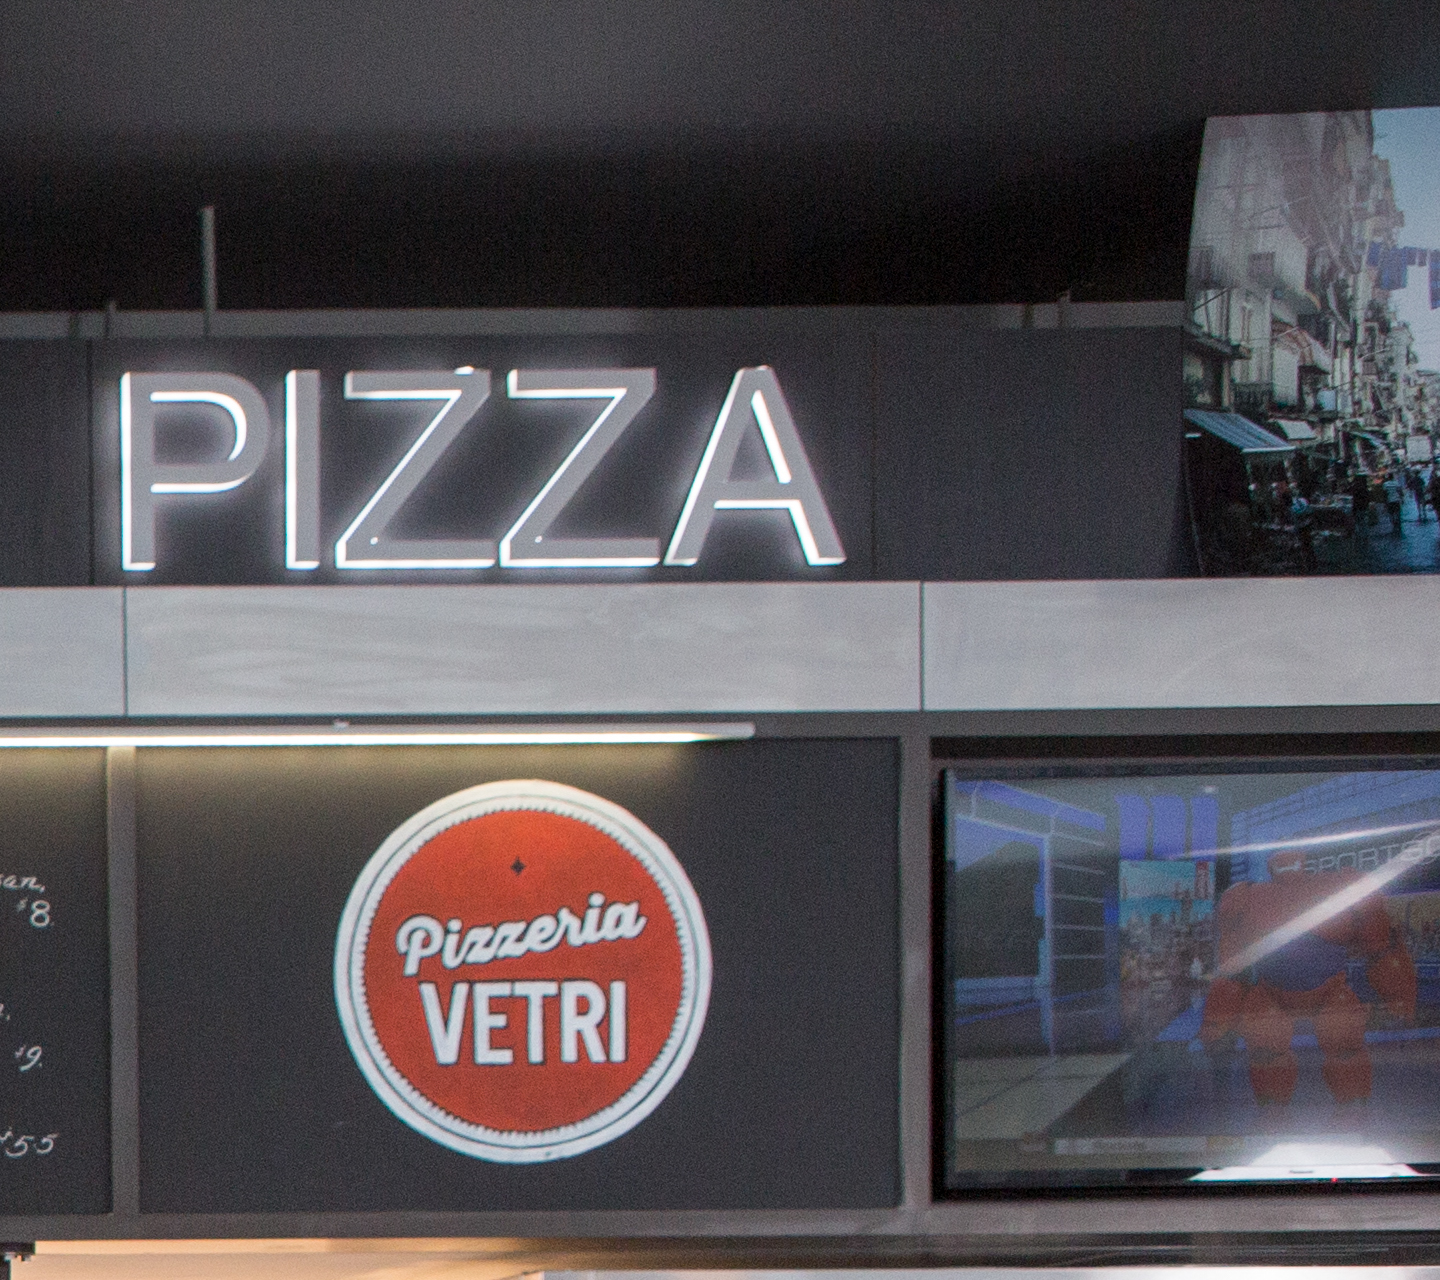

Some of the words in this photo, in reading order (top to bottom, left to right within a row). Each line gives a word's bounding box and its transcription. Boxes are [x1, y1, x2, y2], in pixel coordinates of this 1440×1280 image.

[120, 365, 846, 571] PIZZA
[396, 892, 648, 978] Pizzeria
[418, 978, 628, 1066] VETRI
